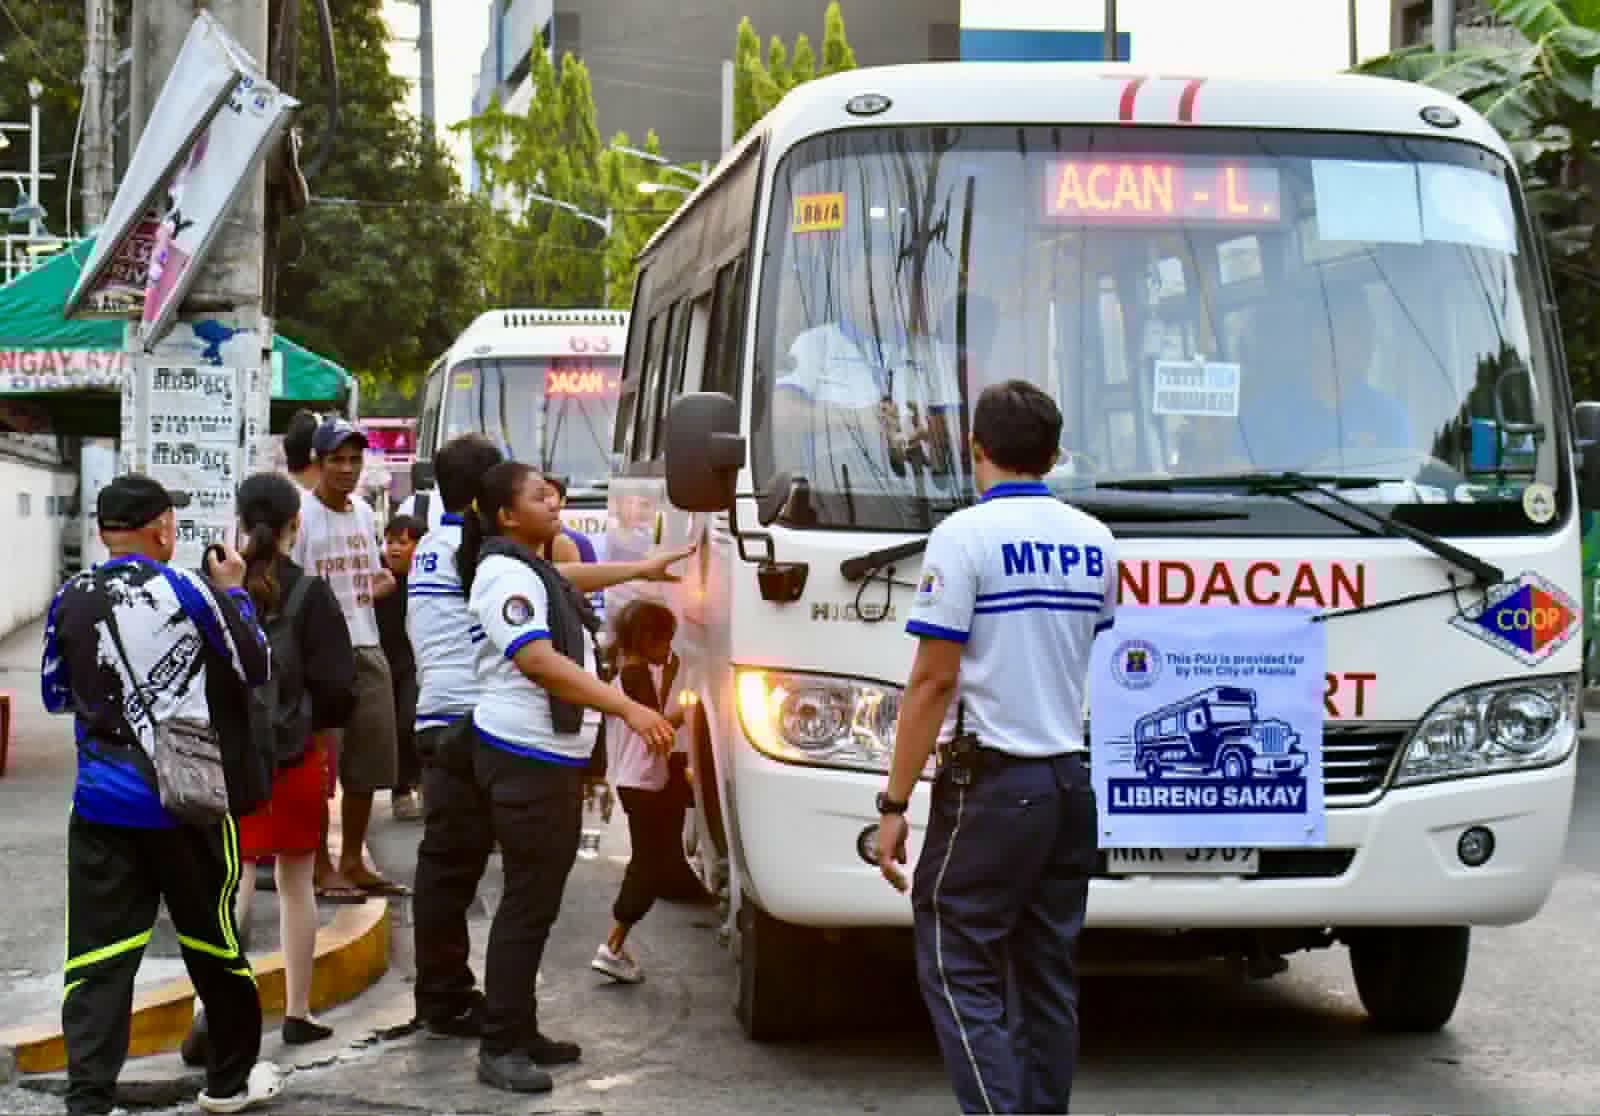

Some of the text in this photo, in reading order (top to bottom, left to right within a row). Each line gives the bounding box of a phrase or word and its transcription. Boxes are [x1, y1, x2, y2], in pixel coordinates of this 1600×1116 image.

[1057, 163, 1173, 213] ACAN
[1001, 541, 1104, 576] MTPB
[1116, 560, 1365, 608] NDACAN
[1497, 608, 1560, 631] COOP
[1166, 653, 1191, 665] This
[1233, 653, 1286, 667] provided
[1195, 665, 1213, 676] the
[1112, 786, 1304, 807] LIBRENG SAKAY
